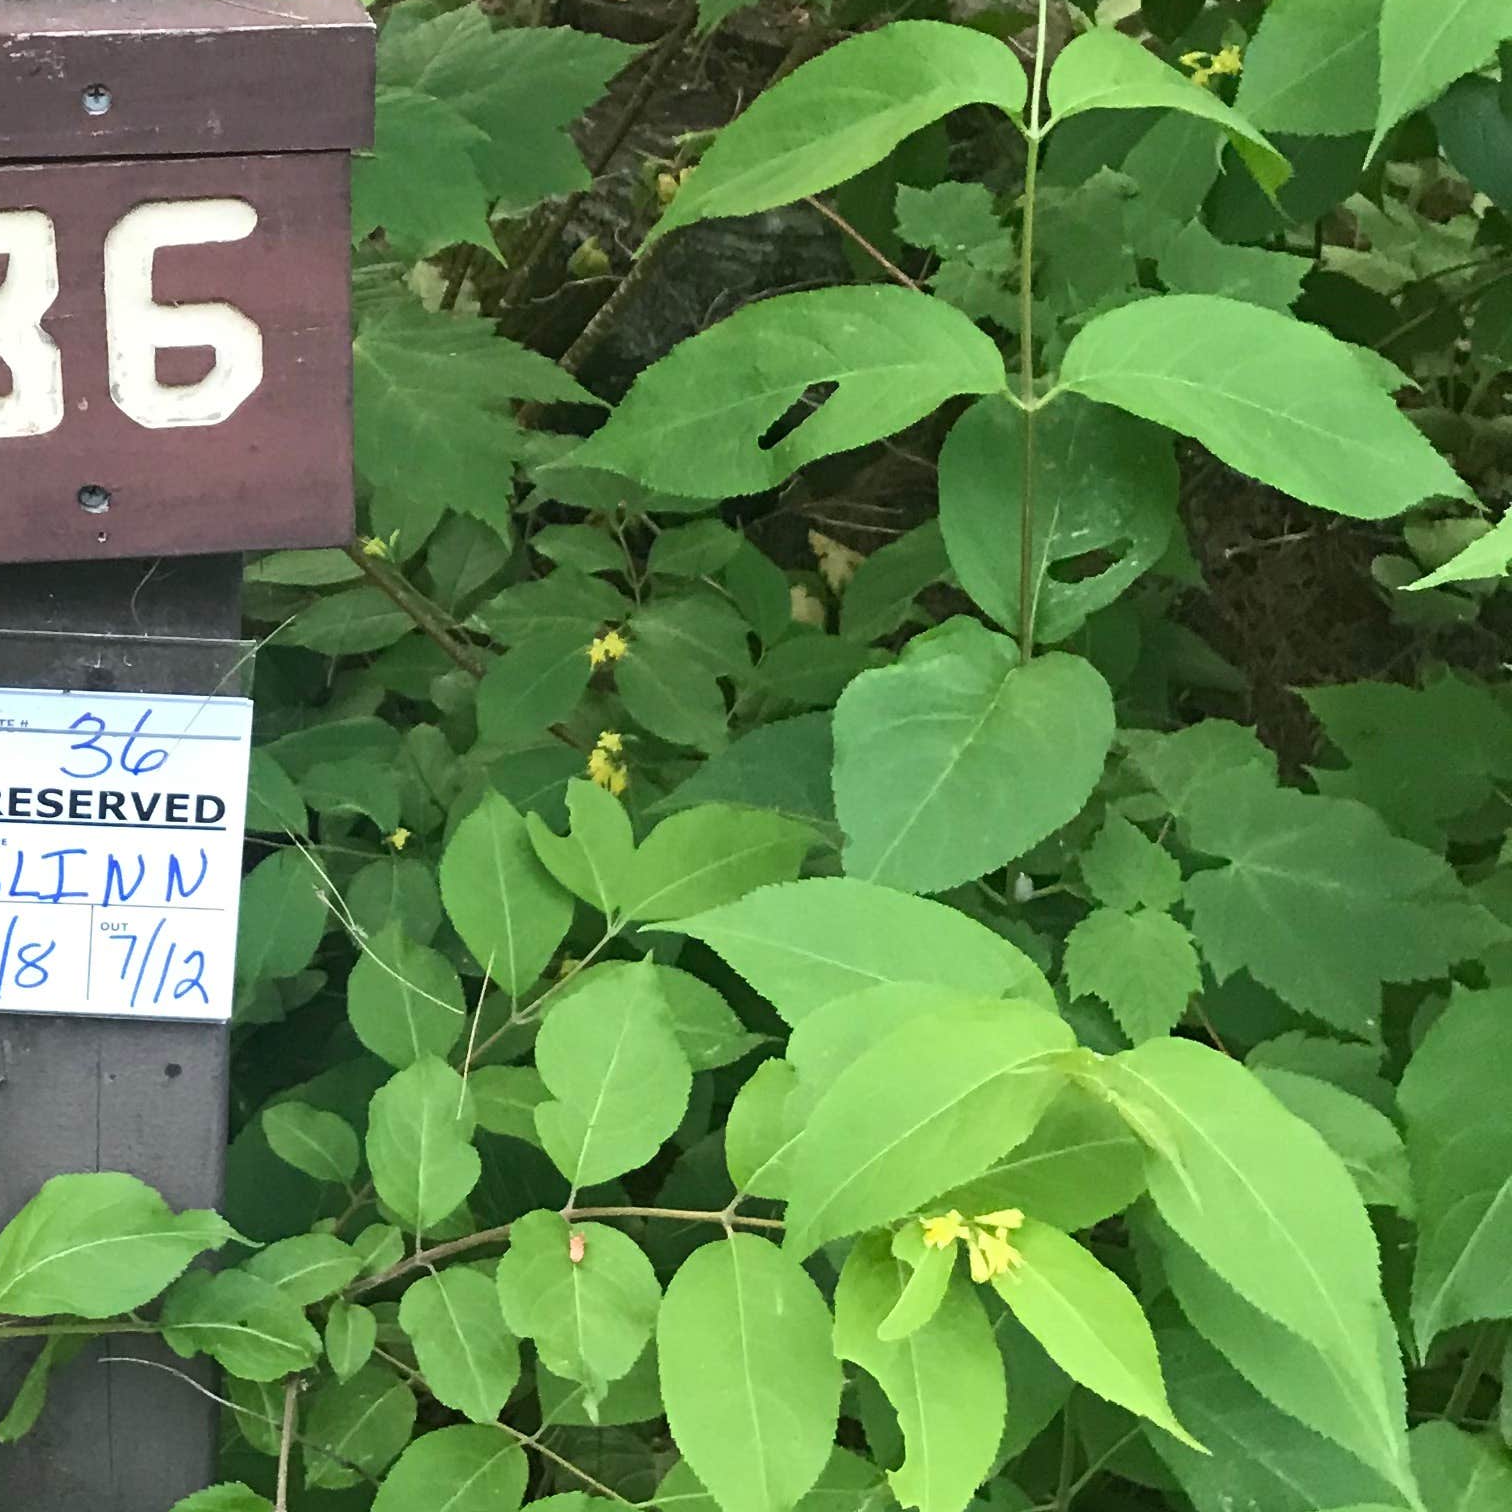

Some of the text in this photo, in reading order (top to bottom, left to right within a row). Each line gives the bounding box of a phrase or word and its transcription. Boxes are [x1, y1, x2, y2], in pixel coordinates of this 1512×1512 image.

[60, 709, 168, 778] 36
[100, 921, 129, 932] OUT
[109, 918, 209, 1007] 7/12
